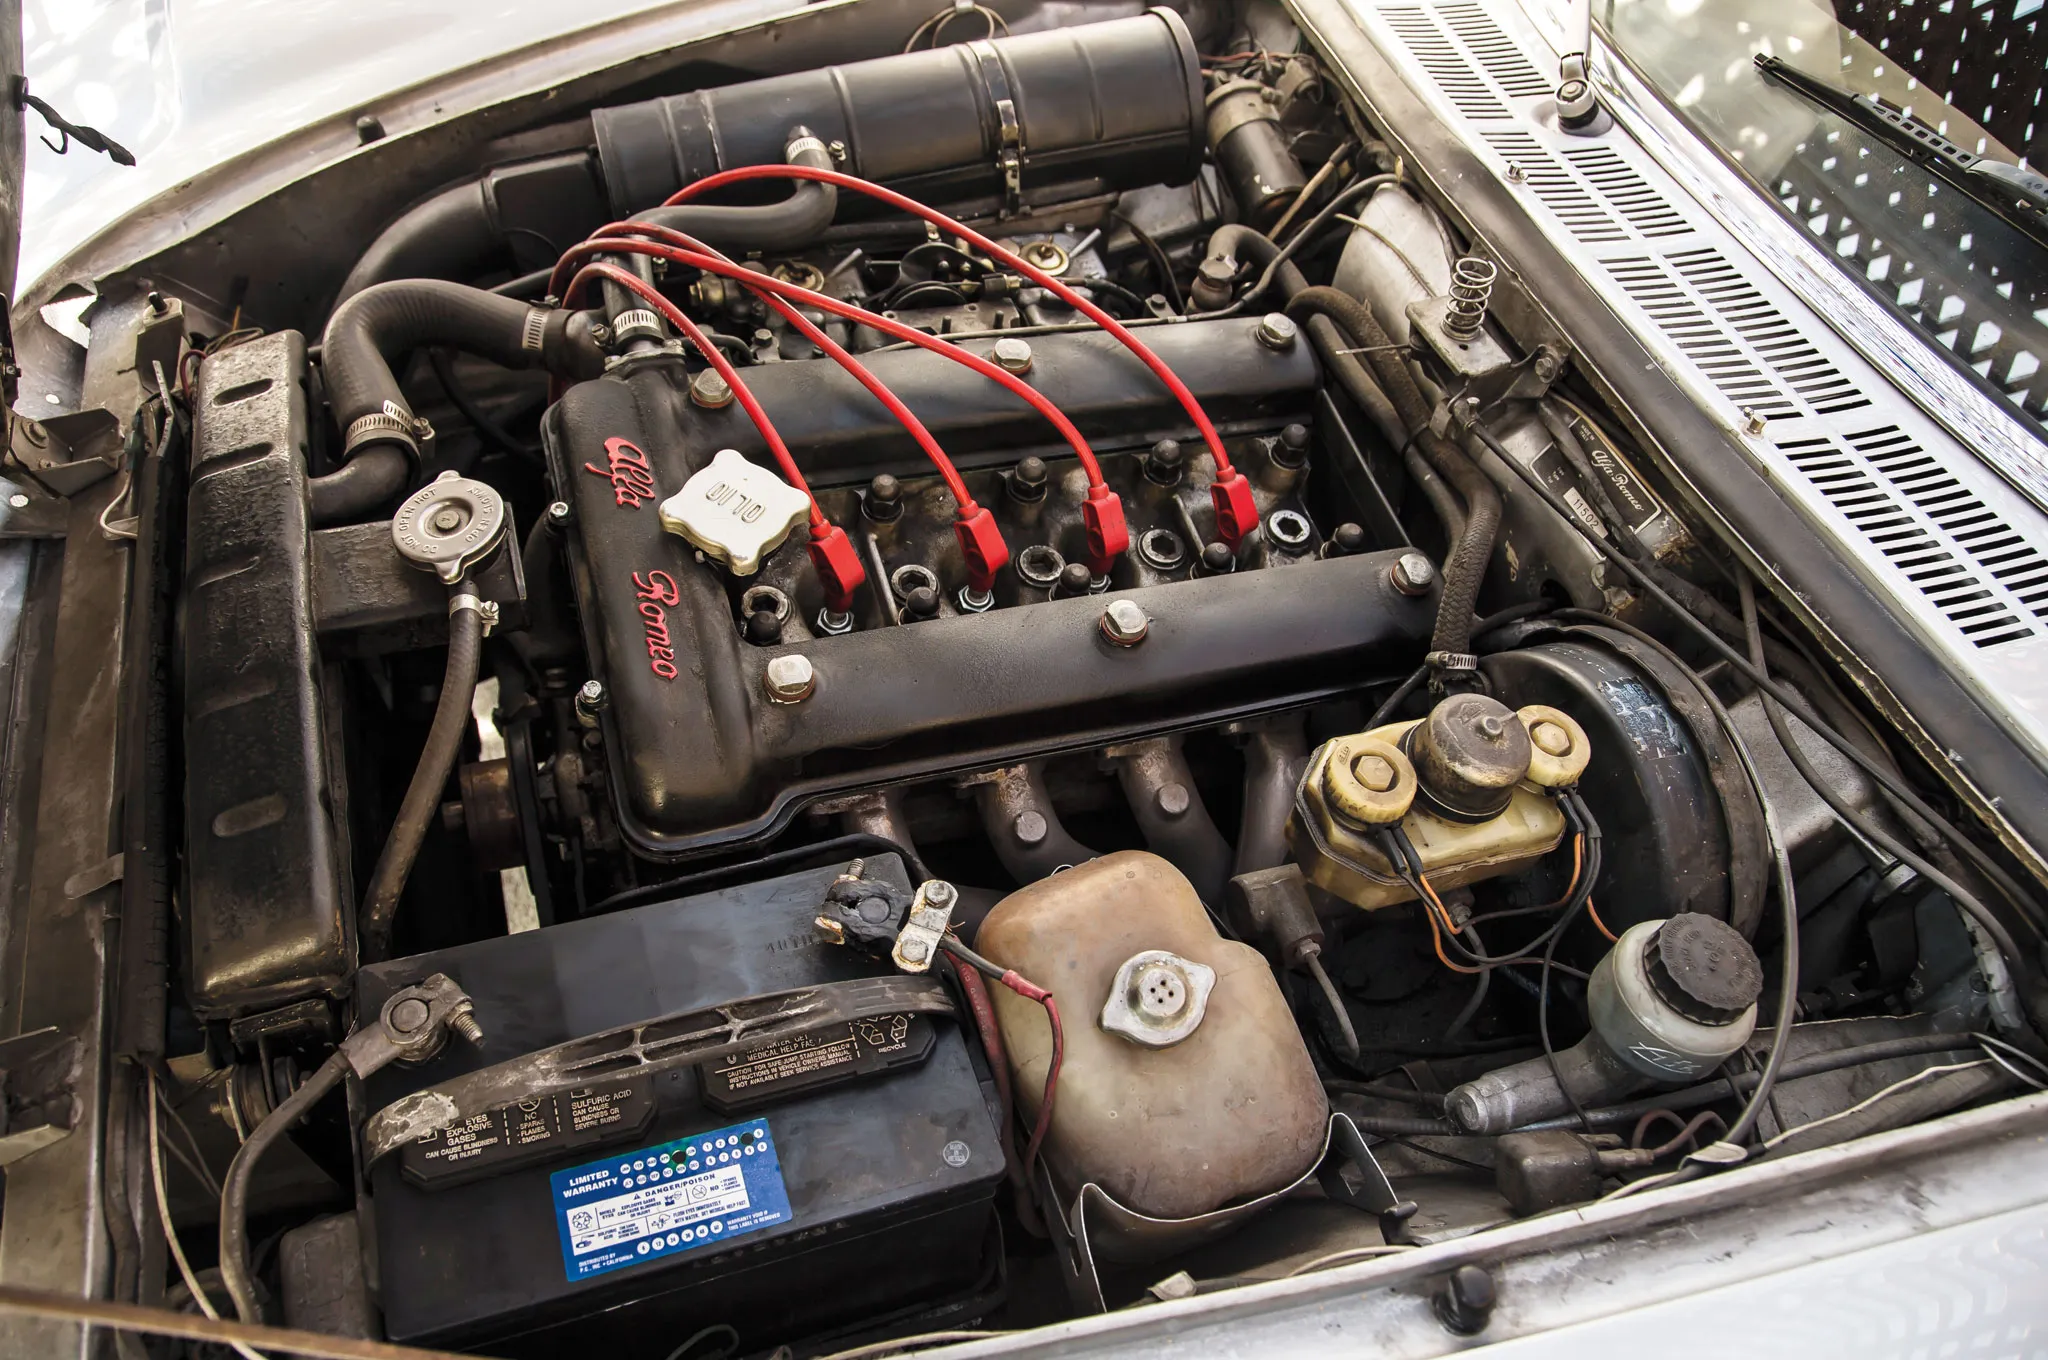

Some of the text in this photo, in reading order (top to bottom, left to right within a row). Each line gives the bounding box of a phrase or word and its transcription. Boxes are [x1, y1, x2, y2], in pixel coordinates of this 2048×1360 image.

[585, 437, 656, 509] Alfa
[705, 481, 767, 524] OLIO
[399, 488, 439, 554] DO NOT OPEN HOT
[1573, 498, 1600, 529] 11502
[465, 519, 490, 543] OPEN
[632, 570, 680, 680] Romeo
[746, 1048, 778, 1061] MEDICAL
[779, 1043, 798, 1053] HELP
[877, 1043, 907, 1053] RECYCLE
[726, 1068, 752, 1078] CAUTION
[766, 1059, 782, 1068] SAFE
[782, 1055, 798, 1064] JUMP
[799, 1049, 827, 1059] STARTING
[827, 1043, 850, 1053] FOLLOW
[728, 1069, 769, 1083] INSTRUCTIONS
[778, 1061, 801, 1072] VEHICLE
[801, 1054, 826, 1065] OWNERS
[826, 1048, 849, 1059] MANUAL
[736, 1080, 748, 1088] NOT
[749, 1073, 778, 1084] AVAILABLE
[779, 1068, 794, 1078] SEEK
[819, 1055, 853, 1067] ASSISTANCE
[570, 1089, 632, 1109] SULFURIC ACID
[523, 1112, 537, 1121] NO
[571, 1102, 609, 1116] CAN CAUSE
[573, 1107, 619, 1122] BLINDNESS OR
[445, 1120, 493, 1137] EXPLOSIVE
[465, 1114, 487, 1125] EYES
[519, 1119, 545, 1129] SPARKS
[574, 1118, 598, 1131] SEVERE
[446, 1133, 476, 1145] GASES
[520, 1126, 545, 1136] FLAMES
[521, 1132, 550, 1143] SMOKING
[425, 1137, 498, 1159] CAN CAUSE BLINDNESS
[447, 1148, 482, 1161] OR INJURY
[562, 1177, 619, 1197] WARRANTY
[568, 1170, 609, 1186] LIMITED
[644, 1173, 716, 1196] DANGER/POISON
